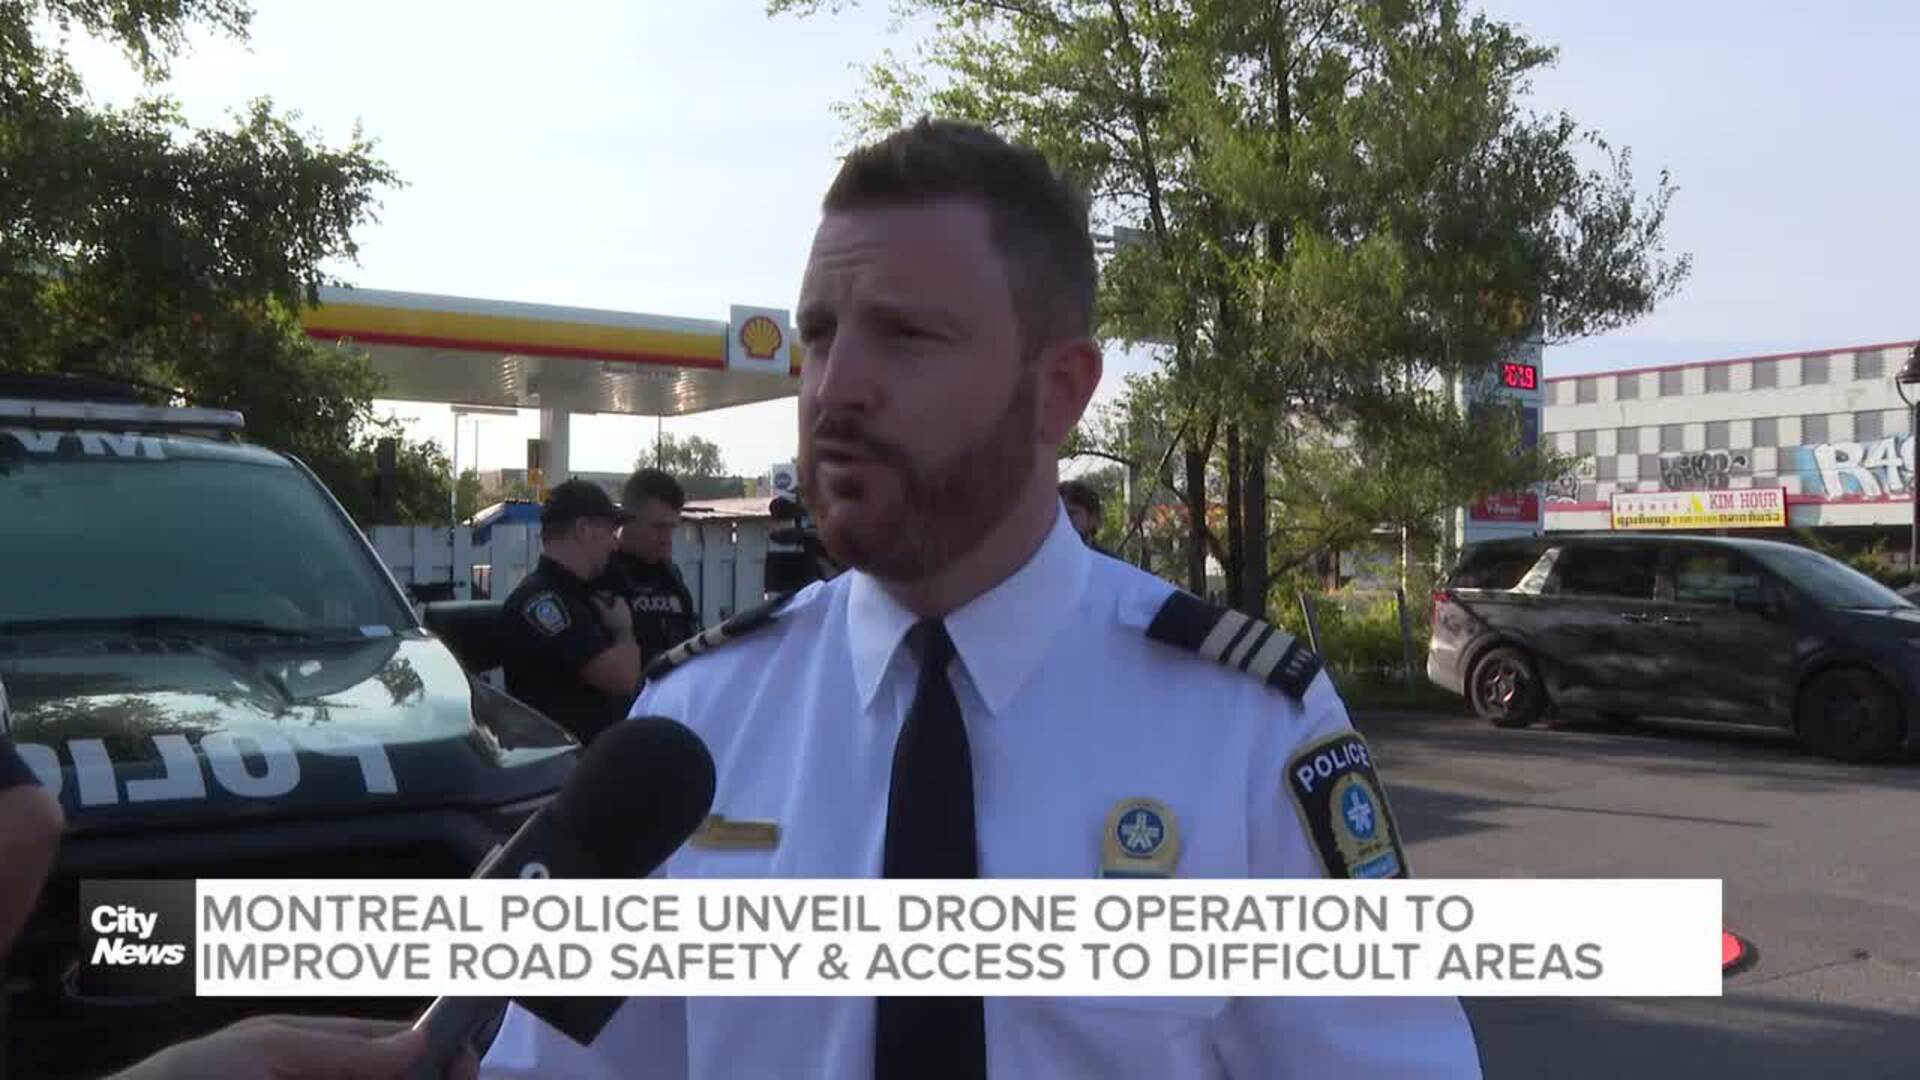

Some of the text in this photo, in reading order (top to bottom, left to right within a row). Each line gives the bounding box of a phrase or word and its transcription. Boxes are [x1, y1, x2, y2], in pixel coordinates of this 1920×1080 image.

[1709, 492, 1778, 510] KIM HOUR
[1296, 742, 1371, 793] POLICE
